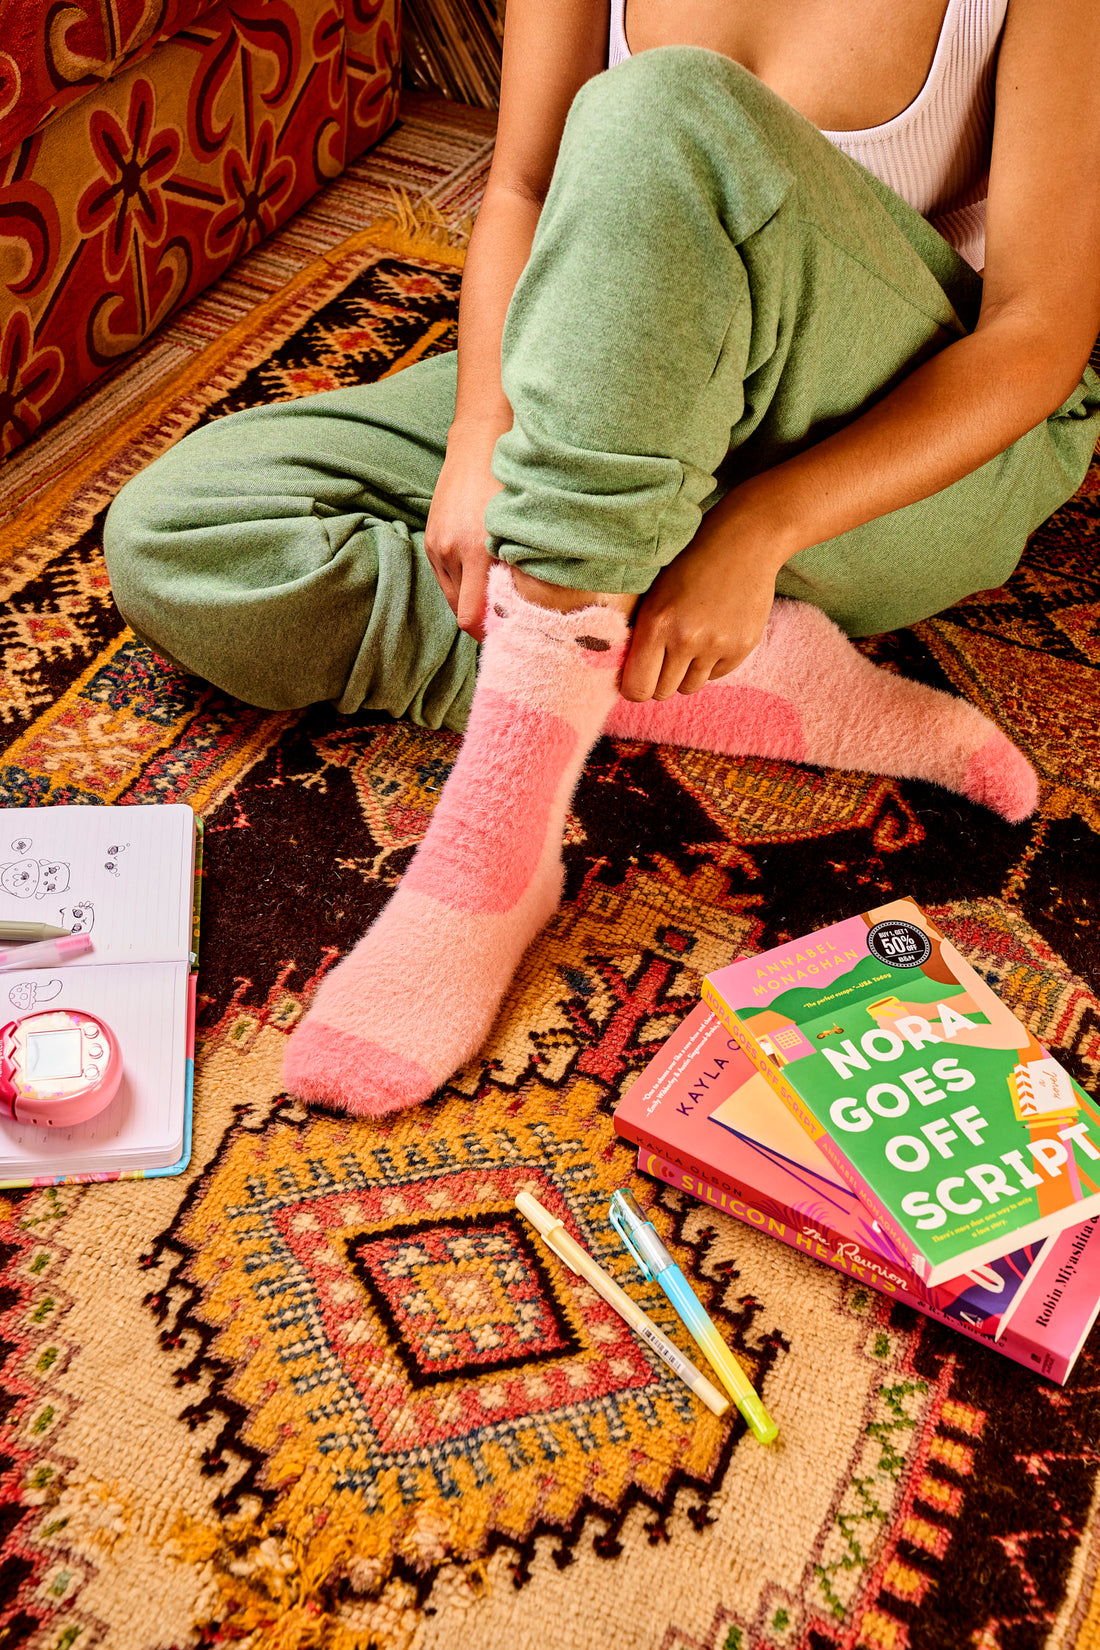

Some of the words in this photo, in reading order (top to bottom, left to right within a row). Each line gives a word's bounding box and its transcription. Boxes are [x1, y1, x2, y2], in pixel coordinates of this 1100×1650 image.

[753, 949, 859, 996] MONAGHAN
[756, 941, 837, 979] ANNABEL
[881, 935, 914, 955] 50%
[872, 973, 891, 982] Today
[706, 990, 731, 1026] NORA
[733, 1025, 758, 1060] GOES
[759, 1060, 779, 1085] OFF
[780, 1086, 817, 1134] SCRIPT
[821, 1003, 979, 1080] NORA
[676, 1058, 729, 1116] KAYLA
[829, 1058, 976, 1132] GOES
[636, 1136, 683, 1166] KAYLA
[690, 1165, 742, 1197] OLSON
[885, 1105, 989, 1172] OFF
[681, 1175, 786, 1237] SILICON
[822, 1143, 857, 1189] ANNABEL
[860, 1190, 908, 1253] MONAGHAN
[901, 1122, 1100, 1230] SCRIPT
[954, 1224, 970, 1233] more
[970, 1218, 984, 1227] than
[984, 1213, 996, 1221] one
[996, 1207, 1010, 1215] way
[1017, 1197, 1032, 1206] write
[976, 1226, 990, 1234] love
[802, 1226, 830, 1246] The
[837, 1242, 908, 1291] Reunion
[1035, 1289, 1063, 1327] Robin
[1055, 1225, 1094, 1288] Miyashita
